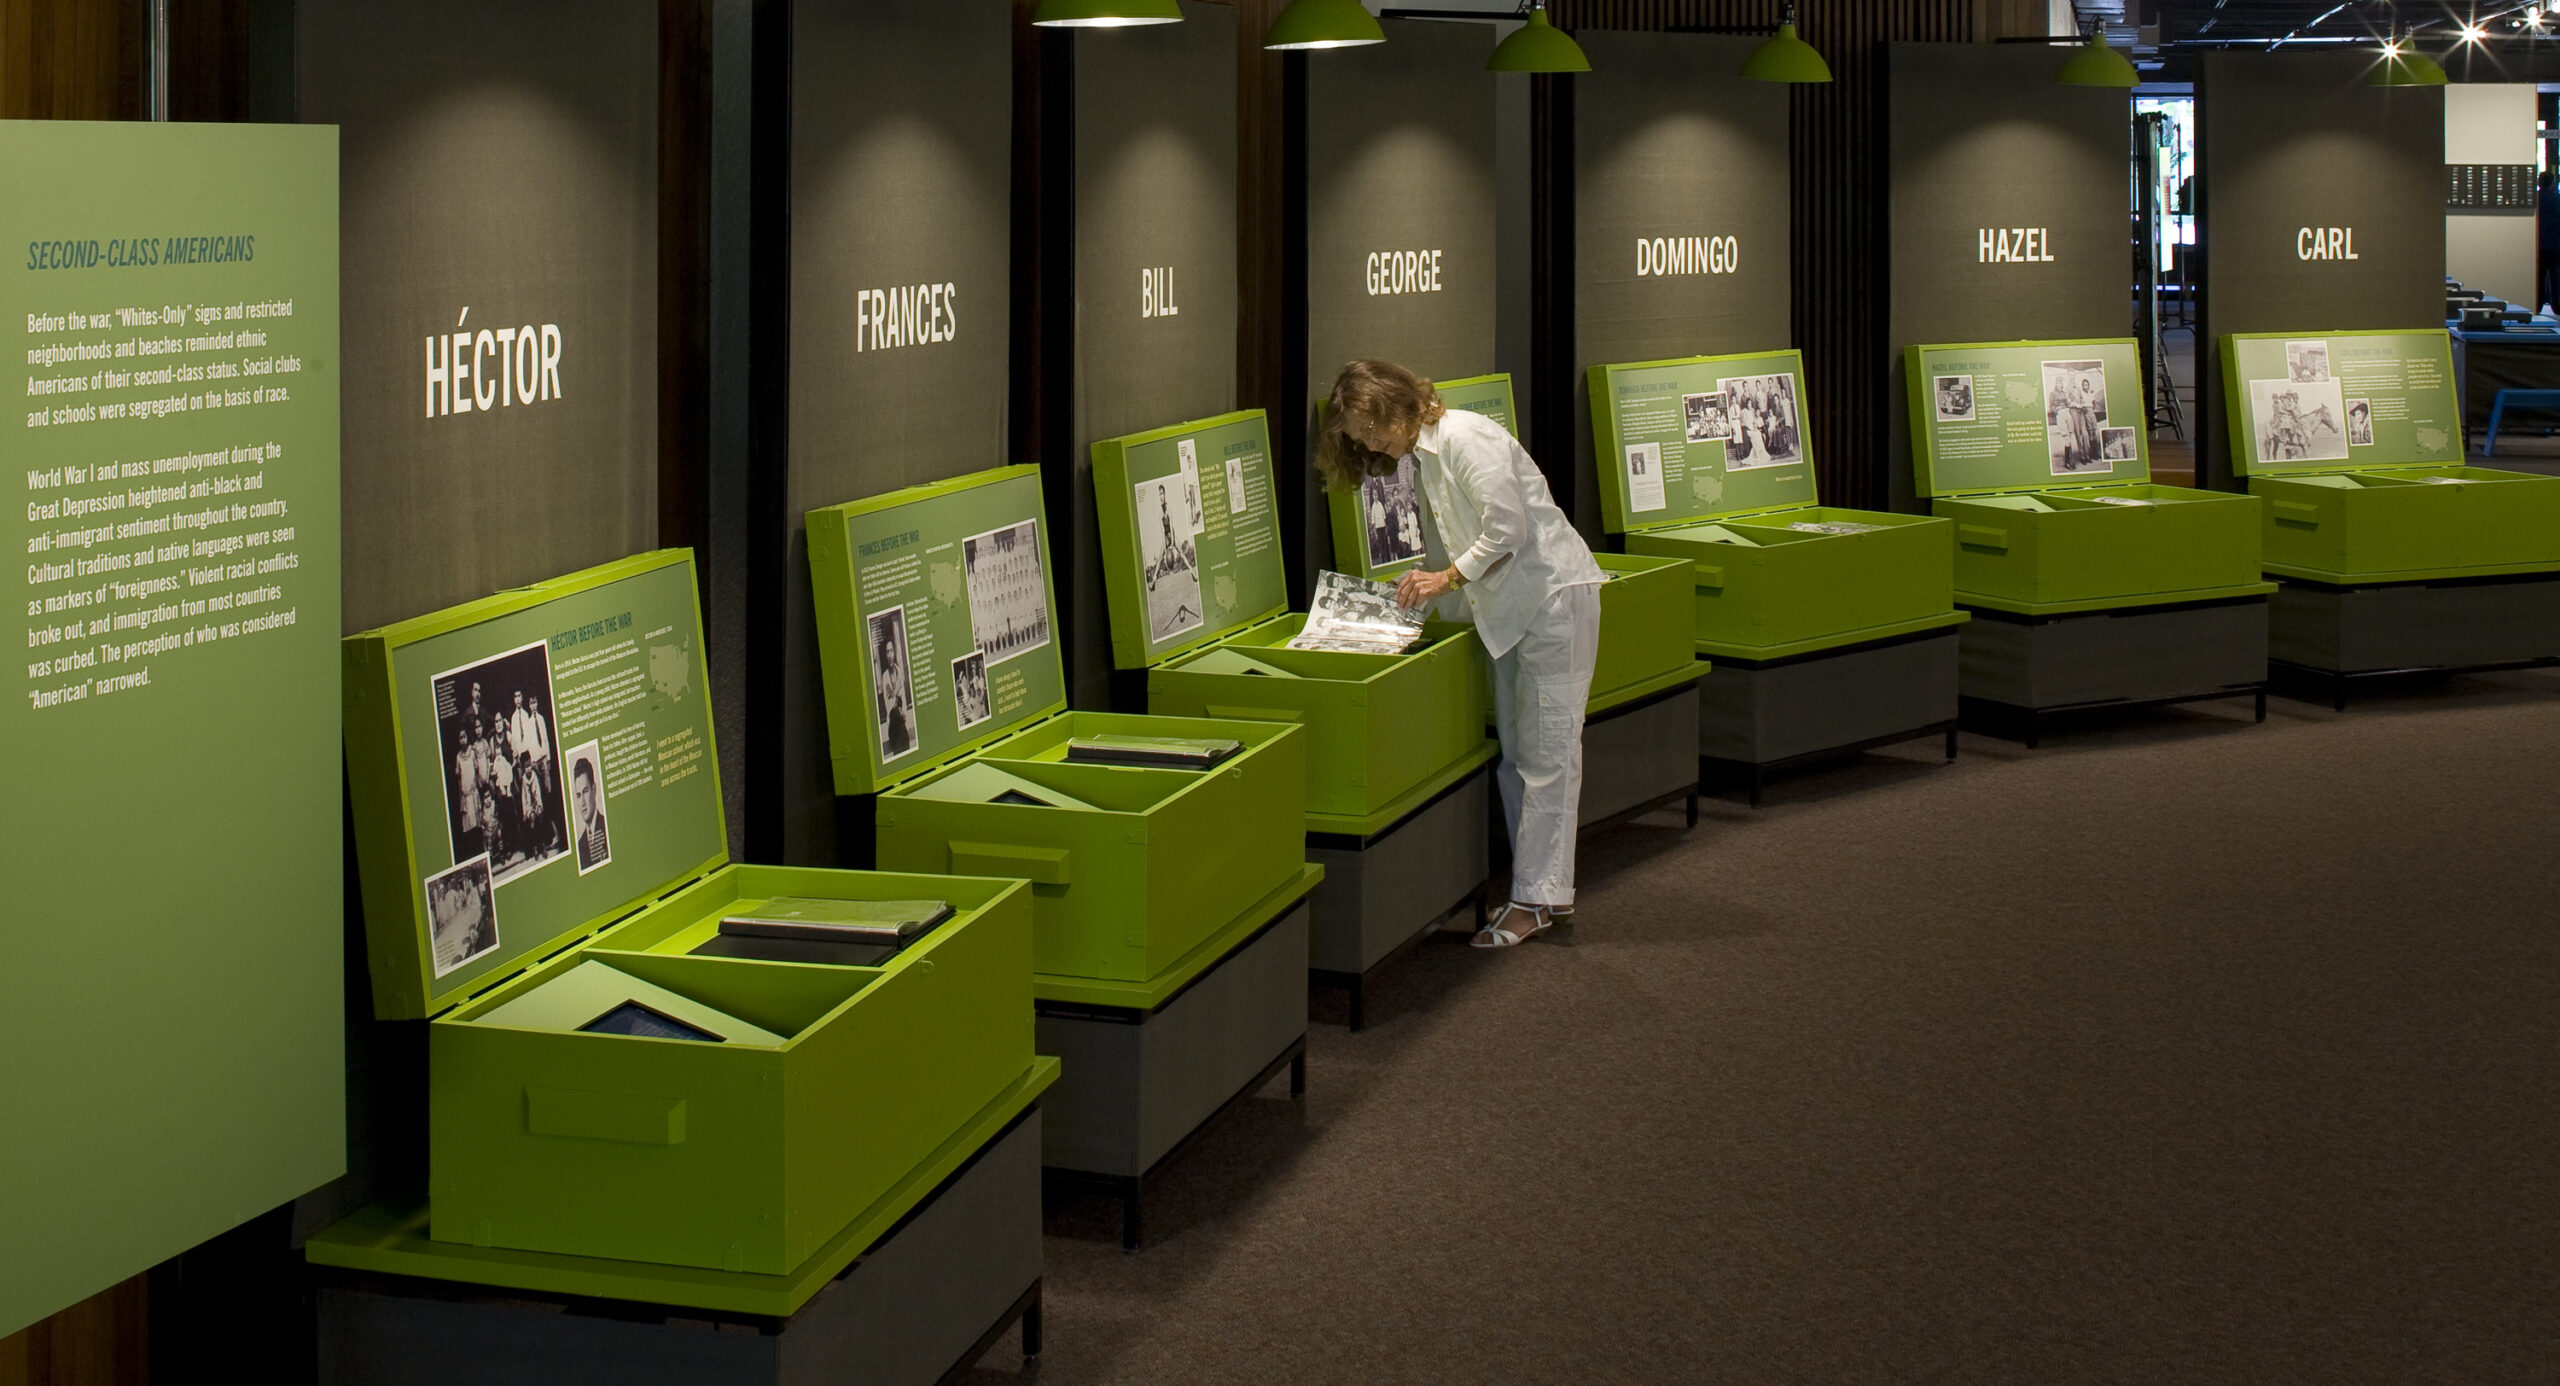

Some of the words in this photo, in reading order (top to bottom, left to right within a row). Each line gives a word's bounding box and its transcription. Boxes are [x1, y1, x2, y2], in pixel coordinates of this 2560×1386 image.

[27, 237, 160, 271] SECOND-CLASS
[163, 234, 255, 265] AMERICANS
[1637, 236, 1737, 275] DOMINGO
[1979, 228, 2054, 262] HAZEL
[2298, 228, 2358, 260] CARL
[1143, 267, 1178, 318] BILL
[1367, 250, 1441, 295] GEORGE
[27, 312, 66, 333] Before
[68, 311, 87, 331] the
[89, 313, 112, 330] war,
[115, 303, 193, 327] “Whites-Only”
[195, 303, 222, 326] signs
[224, 301, 243, 321] and
[245, 298, 293, 319] restricted
[858, 282, 955, 352] FRANCES
[27, 339, 112, 368] neighborhoods
[114, 337, 136, 358] and
[138, 335, 183, 356] beaches
[185, 330, 234, 353] reminded
[236, 328, 267, 348] ethnic
[427, 306, 561, 418] HÉCTOR
[27, 373, 89, 396] Americans
[91, 370, 103, 391] of
[104, 368, 132, 389] their
[133, 363, 204, 387] second-class
[206, 360, 241, 380] status.
[243, 355, 273, 377] Social
[275, 354, 301, 373] clubs
[27, 406, 50, 428] and
[52, 401, 97, 425] schools
[98, 403, 126, 420] were
[128, 392, 188, 420] segregated
[190, 395, 203, 411] on
[205, 390, 222, 409] the
[224, 387, 251, 407] basis
[253, 385, 264, 404] of
[265, 387, 290, 403] race.
[27, 467, 62, 490] World
[64, 465, 88, 486] War
[90, 463, 94, 482] I
[97, 459, 119, 481] and
[121, 460, 151, 478] mass
[153, 447, 229, 475] unemployment
[231, 443, 264, 465] during
[265, 440, 282, 459] the
[27, 499, 60, 522] Great
[62, 491, 125, 519] Depression
[128, 480, 187, 509] heightened
[189, 473, 242, 499] anti-black
[244, 470, 263, 491] and
[27, 522, 115, 554] anti-immigrant
[116, 513, 171, 540] sentiment
[172, 505, 229, 531] throughout
[231, 502, 248, 521] the
[249, 498, 288, 519] country.
[27, 558, 74, 585] Cultural
[77, 551, 132, 577] traditions
[133, 544, 155, 567] and
[157, 541, 190, 563] native
[192, 535, 244, 558] languages
[245, 530, 270, 548] were
[272, 526, 295, 544] seen
[27, 599, 42, 617] as
[45, 589, 93, 613] markers
[95, 583, 107, 604] of
[109, 569, 186, 601] “foreignness.”
[188, 564, 224, 587] Violent
[226, 557, 255, 580] racial
[257, 551, 299, 575] conflicts
[28, 623, 62, 648] broke
[64, 619, 86, 641] out,
[89, 612, 111, 636] and
[113, 602, 179, 631] immigration
[180, 598, 206, 618] from
[208, 591, 234, 612] most
[235, 583, 282, 607] countries
[578, 620, 604, 643] BEFORE
[604, 616, 617, 634] THE
[617, 611, 632, 630] WAR
[28, 660, 52, 679] was
[54, 646, 98, 674] curbed.
[100, 643, 121, 664] The
[123, 631, 181, 664] perception
[183, 626, 195, 647] of
[196, 623, 218, 644] who
[219, 621, 240, 639] was
[242, 606, 296, 635] considered
[28, 677, 93, 710] “American”
[96, 665, 152, 696] narrowed.
